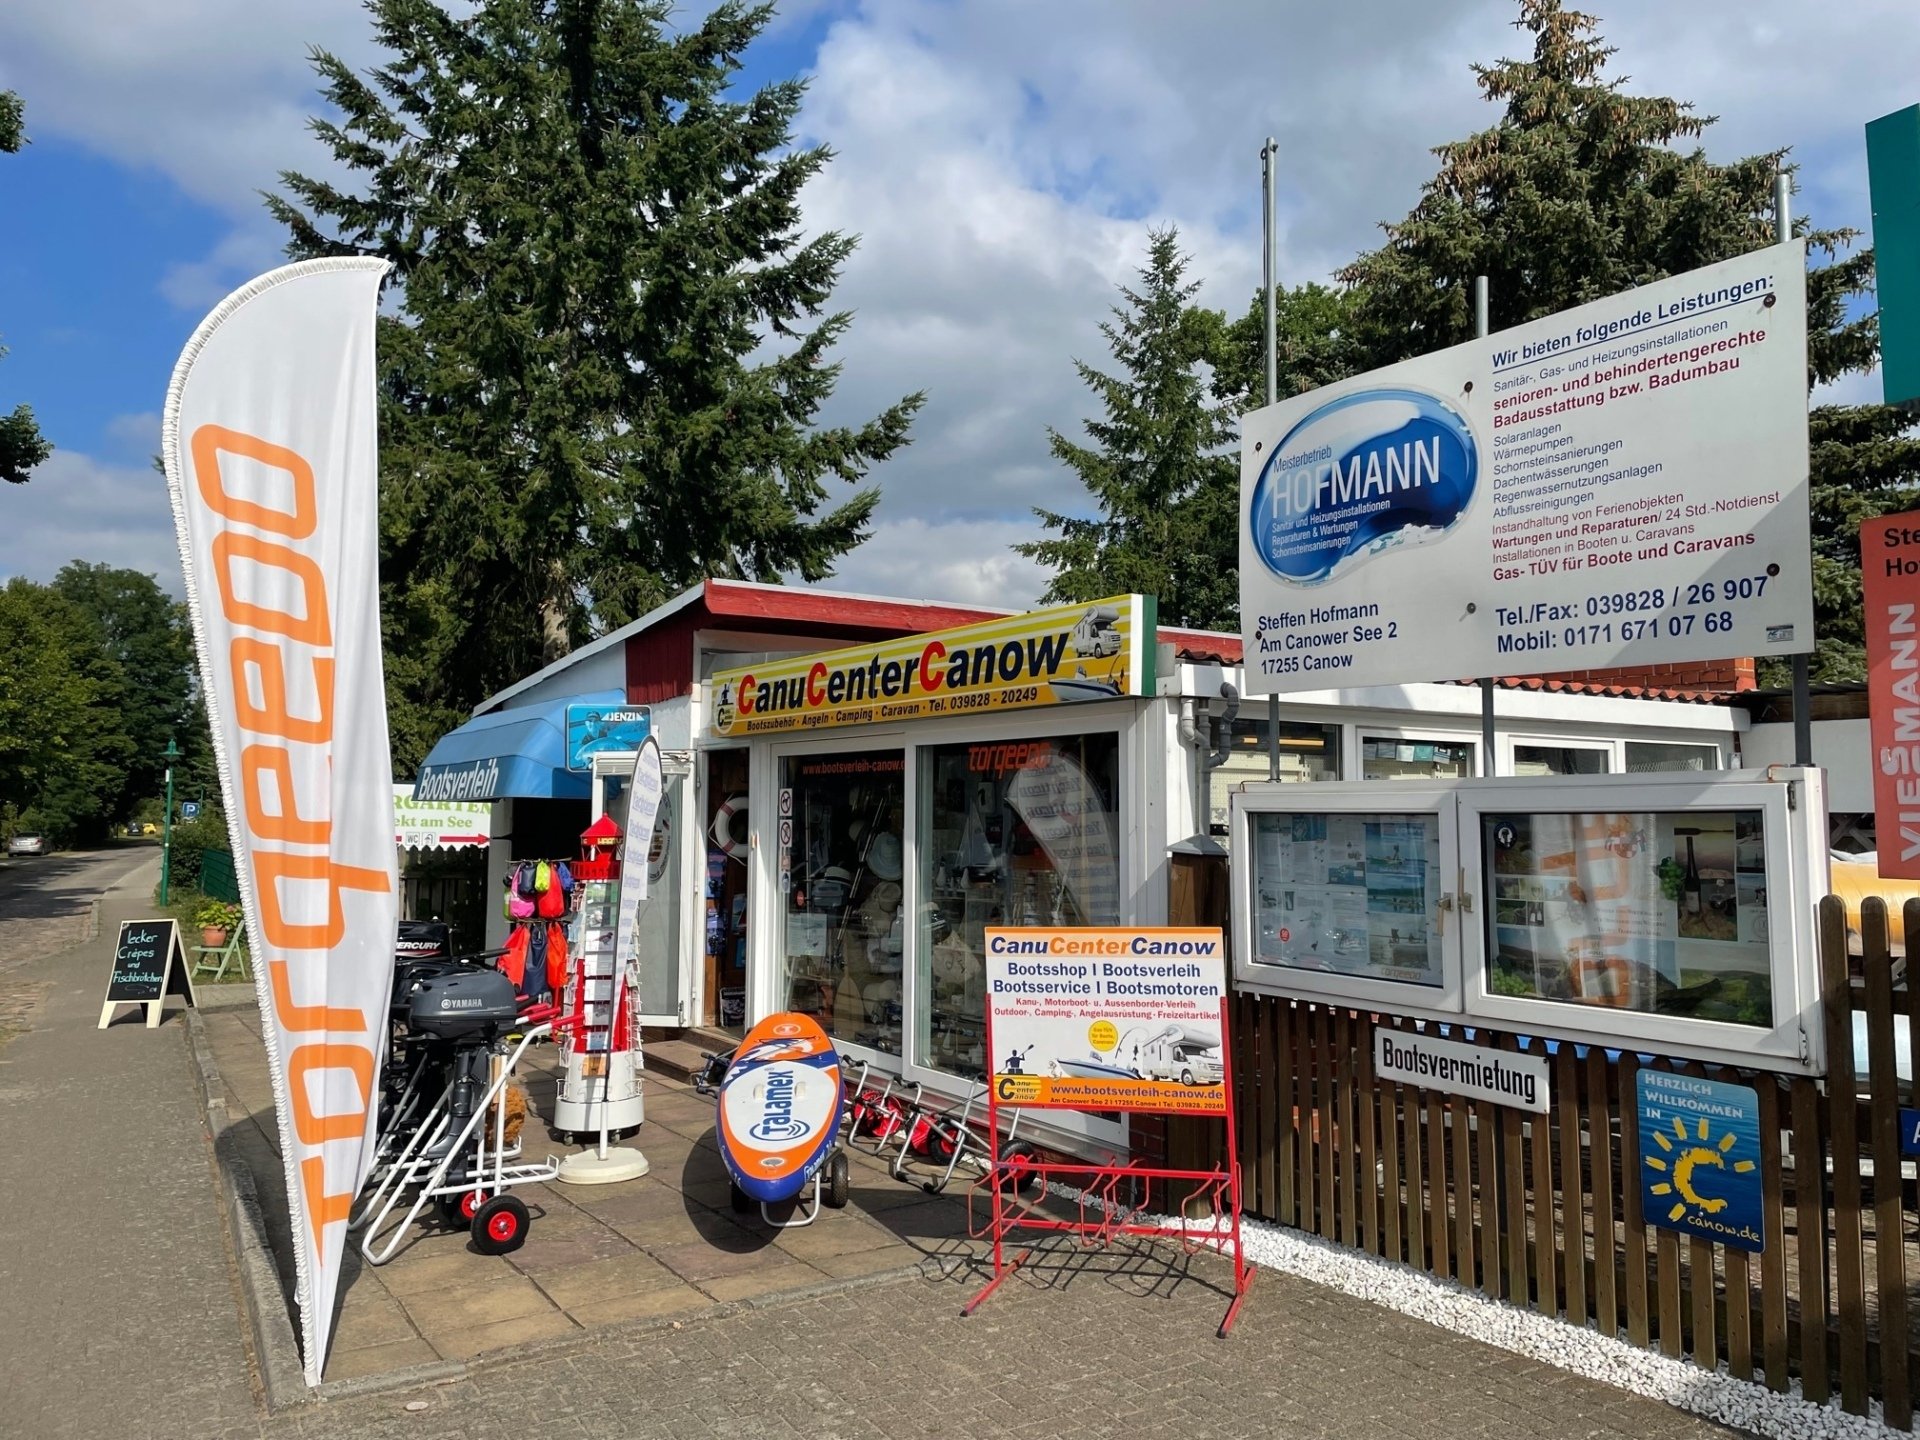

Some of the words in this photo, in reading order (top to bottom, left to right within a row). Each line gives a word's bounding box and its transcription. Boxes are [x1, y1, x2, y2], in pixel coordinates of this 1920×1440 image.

[1492, 348, 1516, 368] Wir
[1523, 336, 1571, 359] bieten
[1576, 311, 1652, 343] folgende
[1658, 275, 1773, 320] Leistungen:
[1494, 371, 1537, 393] Sanitär-,
[1539, 366, 1566, 380] Gas-
[1568, 357, 1589, 373] und
[1592, 320, 1728, 365] Heizungsinstallationen
[1494, 386, 1559, 411] senioren-
[1562, 371, 1590, 393] und
[1594, 329, 1766, 383] behindertengerechte
[1494, 391, 1604, 428] Badausstattung
[1610, 381, 1643, 399] bzw.
[1649, 357, 1740, 389] Badumbau
[1493, 435, 1573, 461] Wärmepumpen
[1494, 423, 1561, 447] Solaranlagen
[1273, 445, 1332, 473] Meisterbetrieb
[1493, 440, 1623, 476] Schornsteinsanierungen
[1272, 435, 1439, 519] HOFMANN
[1493, 458, 1609, 490] Dachentwässerungen
[1493, 463, 1663, 504] Regenwassernutzungsanlagen
[1272, 518, 1293, 533] Sanitär
[1296, 516, 1308, 529] und
[1310, 500, 1390, 524] Heizungsinstallationen
[1493, 491, 1594, 518] Abflussreinigungen
[1493, 513, 1568, 535] Instandhaltung
[1572, 509, 1592, 522] von
[1596, 493, 1684, 517] Ferienobjekten
[1272, 529, 1311, 546] Reparaturen
[1312, 528, 1318, 537] &
[1320, 521, 1358, 537] Wartungen
[1492, 530, 1552, 550] Wartungen
[1556, 524, 1578, 538] und
[1666, 508, 1680, 520] 24
[1685, 491, 1780, 517] Std.-Notdienst
[1272, 536, 1351, 559] Schornsteinsanierungen
[1493, 544, 1561, 564] Installationen
[1564, 541, 1574, 552] in
[1577, 532, 1618, 551] Booten
[1621, 534, 1631, 544] u.
[1636, 524, 1695, 542] Caravans
[1493, 567, 1525, 581] Gas-
[1529, 558, 1559, 575] TÜV
[1562, 557, 1584, 571] für
[1587, 548, 1632, 568] Boote
[1638, 542, 1668, 560] und
[1673, 533, 1755, 554] Caravans
[1496, 603, 1579, 627] Tel./Fax:
[1586, 589, 1664, 616] 039828
[1672, 586, 1679, 607] /
[1687, 583, 1715, 605] 26
[1724, 576, 1768, 600] 907
[1258, 613, 1306, 631] Steffen
[1310, 604, 1379, 624] Hofmann
[1260, 639, 1281, 653] Am
[1286, 630, 1348, 650] Canower
[1353, 627, 1382, 642] See
[1388, 622, 1397, 638] 2
[1498, 630, 1557, 653] Mobil:
[1564, 624, 1611, 646] 0171
[1621, 619, 1658, 641] 671
[1669, 615, 1695, 637] 07
[1705, 611, 1732, 632] 68
[738, 632, 1071, 714] CanuCenterCanow
[1261, 657, 1299, 674] 17255
[1303, 655, 1353, 670] Canow
[609, 712, 635, 721] JENZI
[747, 716, 795, 730] Bootszubehör
[802, 713, 828, 726] Angeln
[836, 709, 873, 722] Camping
[881, 704, 919, 717] Caravan
[929, 699, 947, 711] Tel.
[950, 693, 989, 709] 039828
[1001, 688, 1037, 704] 20249
[418, 758, 499, 800] Bootsverleih
[186, 804, 195, 816] P
[420, 819, 443, 827] am
[448, 816, 472, 827] See
[991, 937, 1216, 955] CanuCenterCanow
[1008, 963, 1087, 978] Bootsshop
[1103, 963, 1200, 977] Bootsverleih
[994, 980, 1090, 994] Bootsservice
[1107, 981, 1218, 996] Bootsmotoren
[452, 999, 482, 1008] YAMAHA
[1045, 999, 1091, 1007] Motorboot-
[1158, 1010, 1220, 1020] Freizeitartikel
[1383, 1037, 1536, 1104] Bootsvermietung
[1645, 1074, 1711, 1095] HERZLICH
[1051, 1085, 1223, 1099] www.bootsverleih-canow.de
[1645, 1090, 1743, 1118] WILLKOMMEN
[1646, 1108, 1660, 1119] IN
[1687, 1215, 1760, 1242] canow.de
